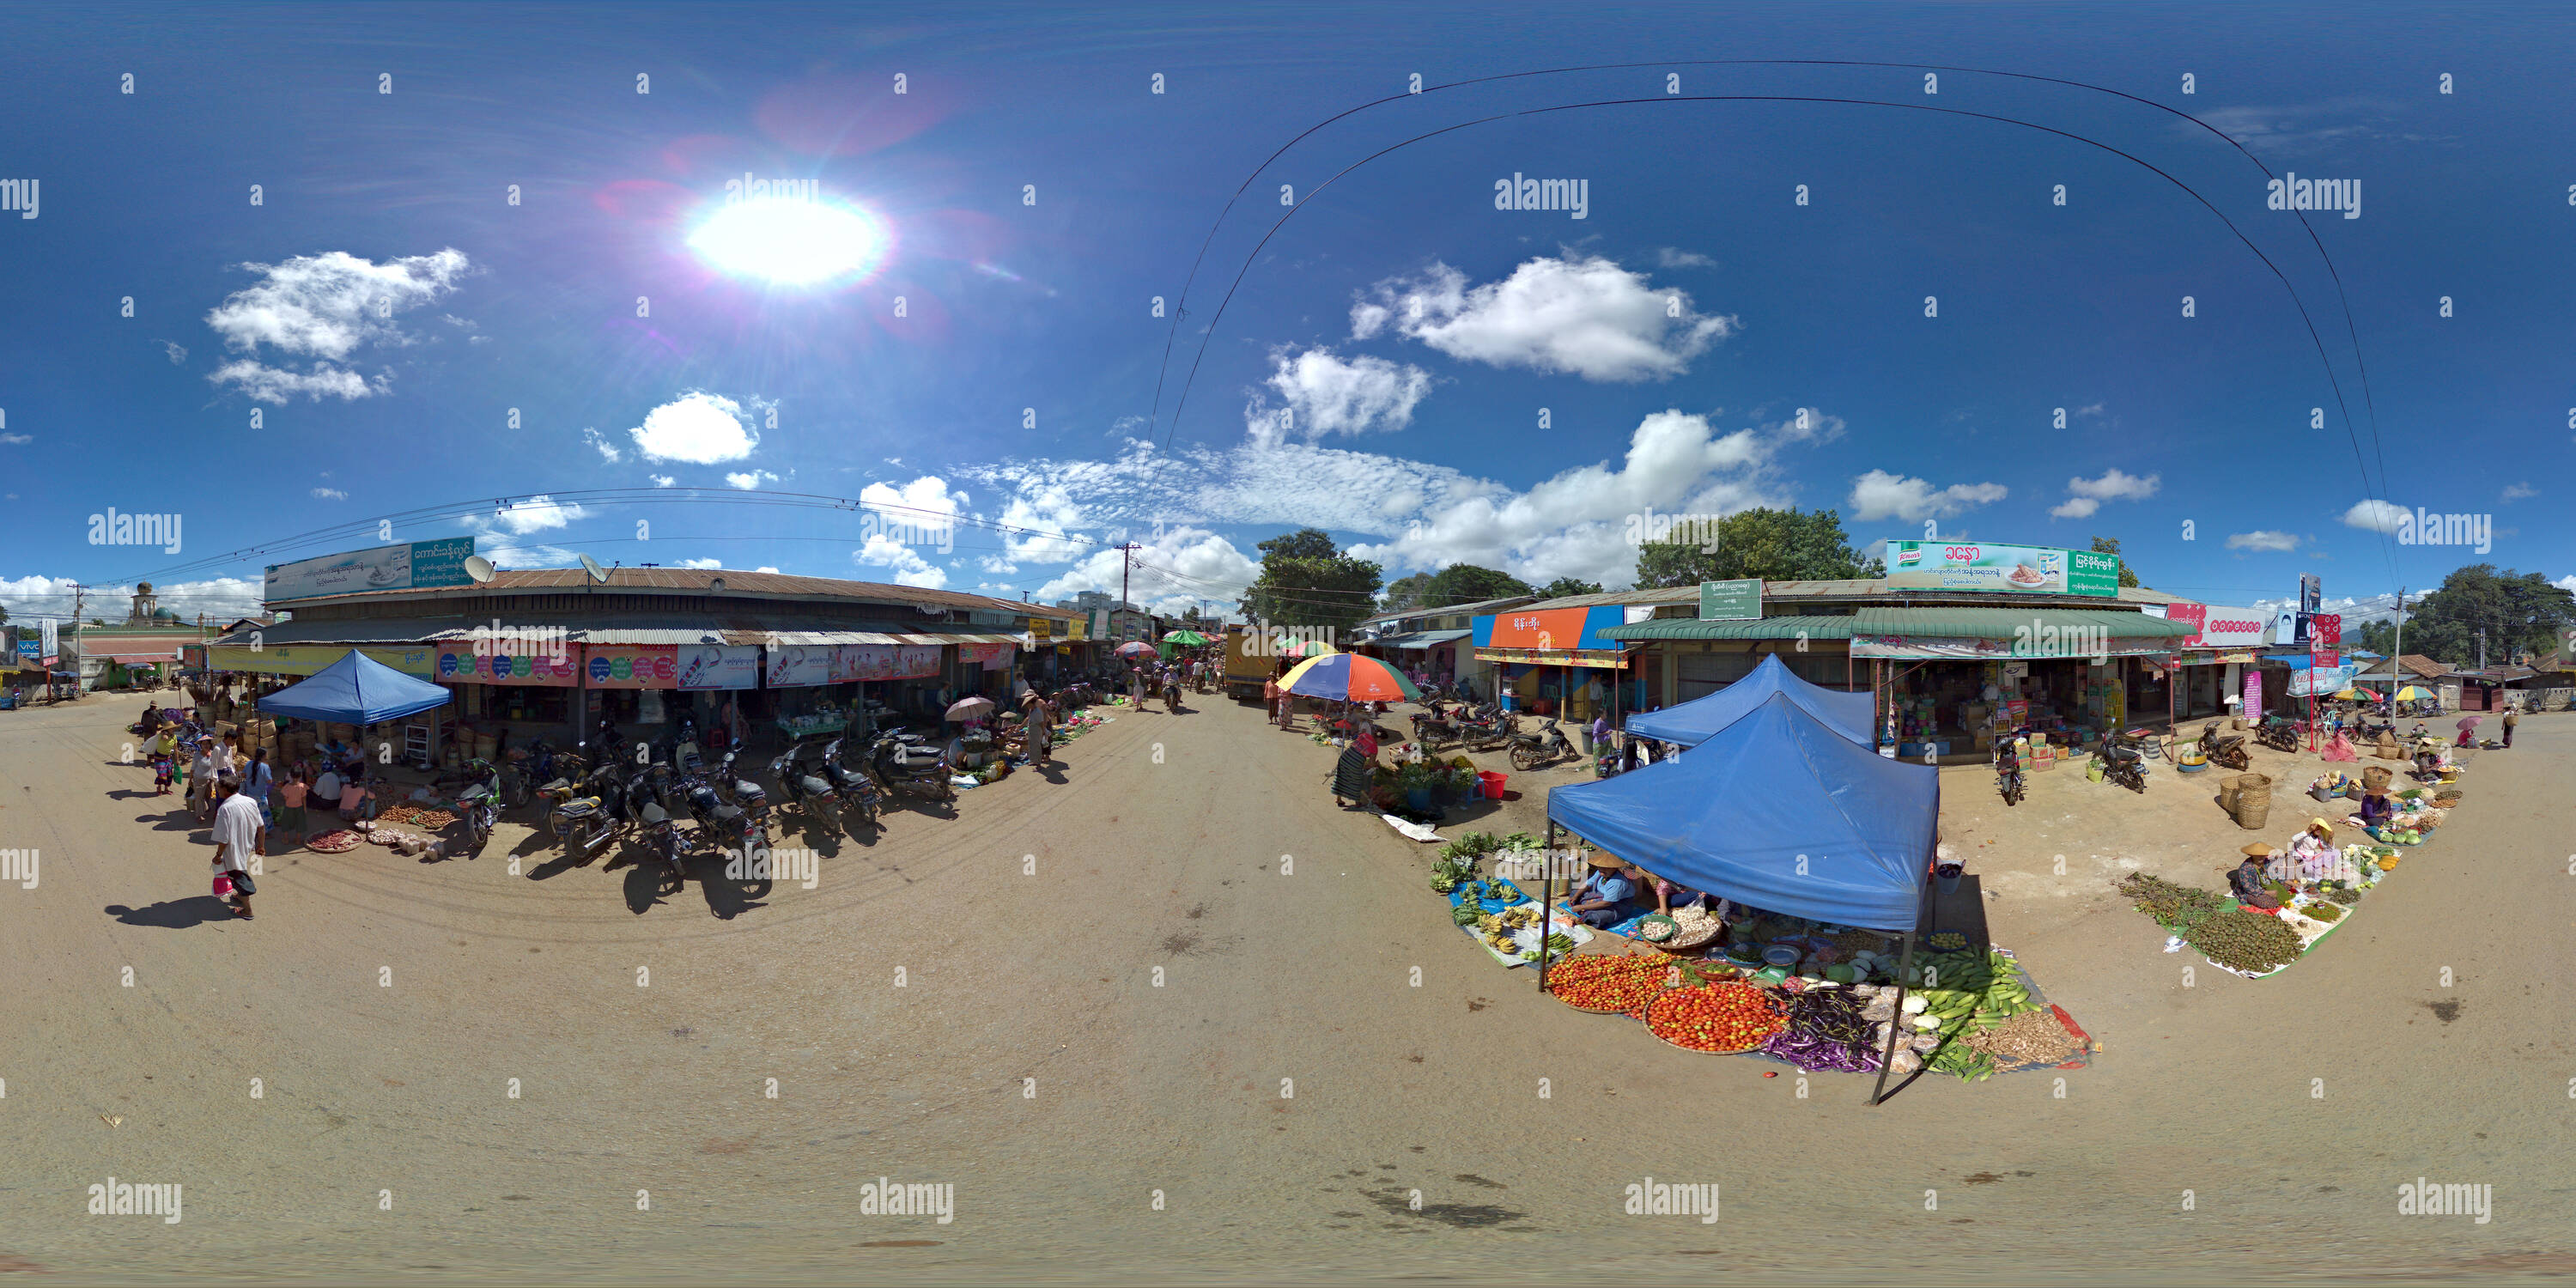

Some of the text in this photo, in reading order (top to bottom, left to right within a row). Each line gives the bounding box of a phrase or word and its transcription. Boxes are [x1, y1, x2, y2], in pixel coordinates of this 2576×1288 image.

[1899, 552, 1921, 561] Knorr
[1945, 546, 1980, 566] ခနော
[2211, 620, 2260, 632] ooredoo
